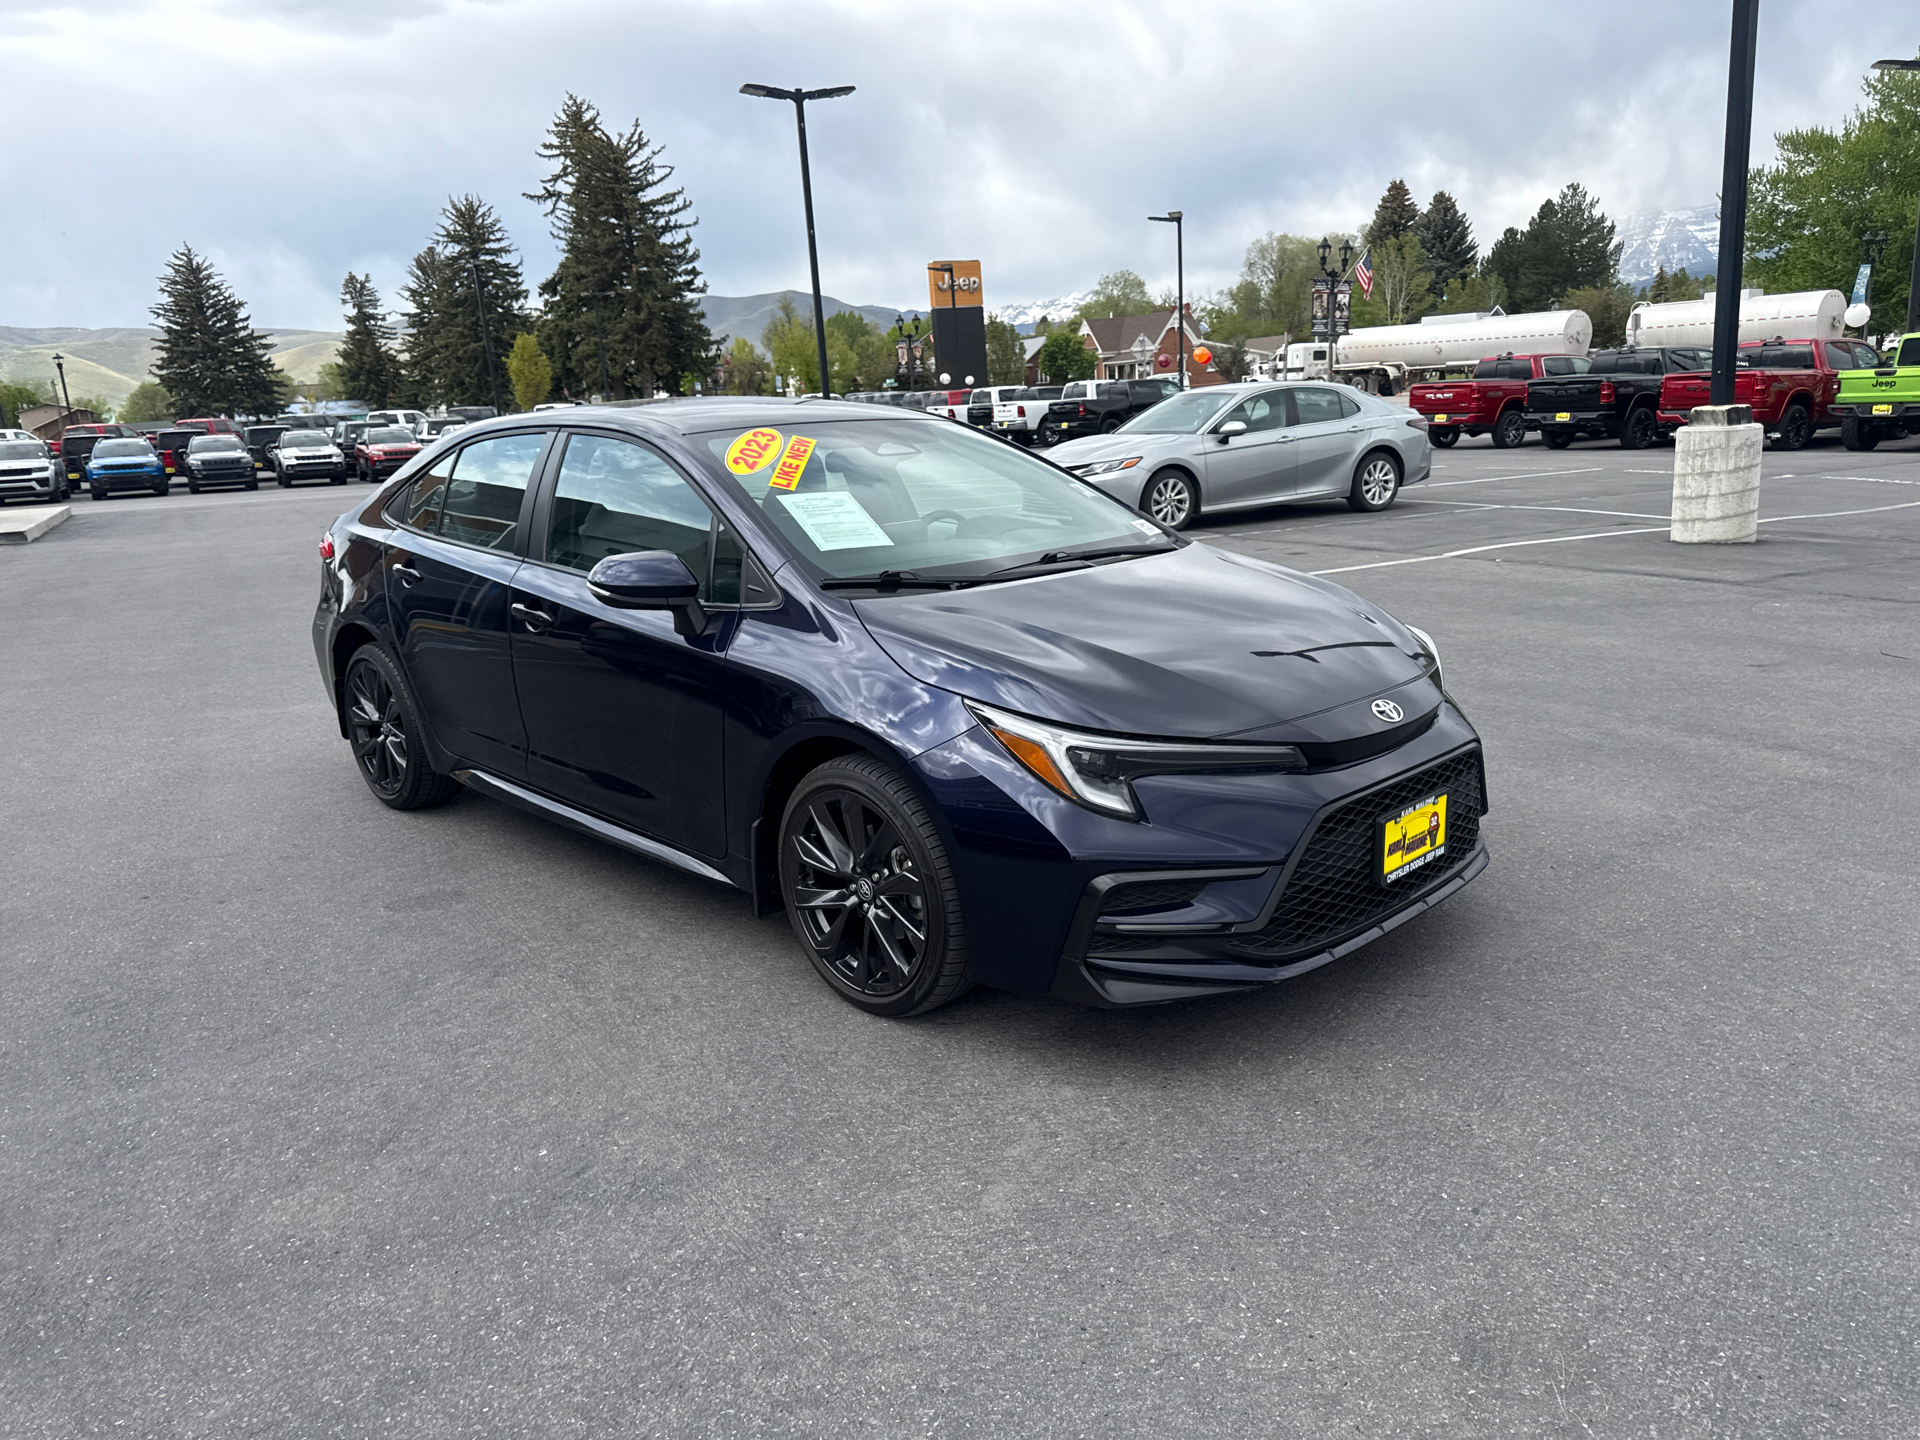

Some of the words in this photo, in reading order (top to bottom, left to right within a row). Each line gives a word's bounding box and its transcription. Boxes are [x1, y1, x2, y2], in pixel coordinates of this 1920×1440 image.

[937, 273, 980, 294] Jeep
[1871, 380, 1896, 388] Jeep
[732, 430, 778, 471] 2023
[772, 461, 801, 490] LIKE
[790, 437, 812, 462] NEW
[1401, 806, 1415, 818] KARL
[1415, 795, 1435, 809] MALONE
[1386, 865, 1409, 883] CHRYSLER
[1410, 856, 1425, 871] DODGE
[1425, 851, 1435, 863] JEEP
[1435, 845, 1445, 857] RAM
